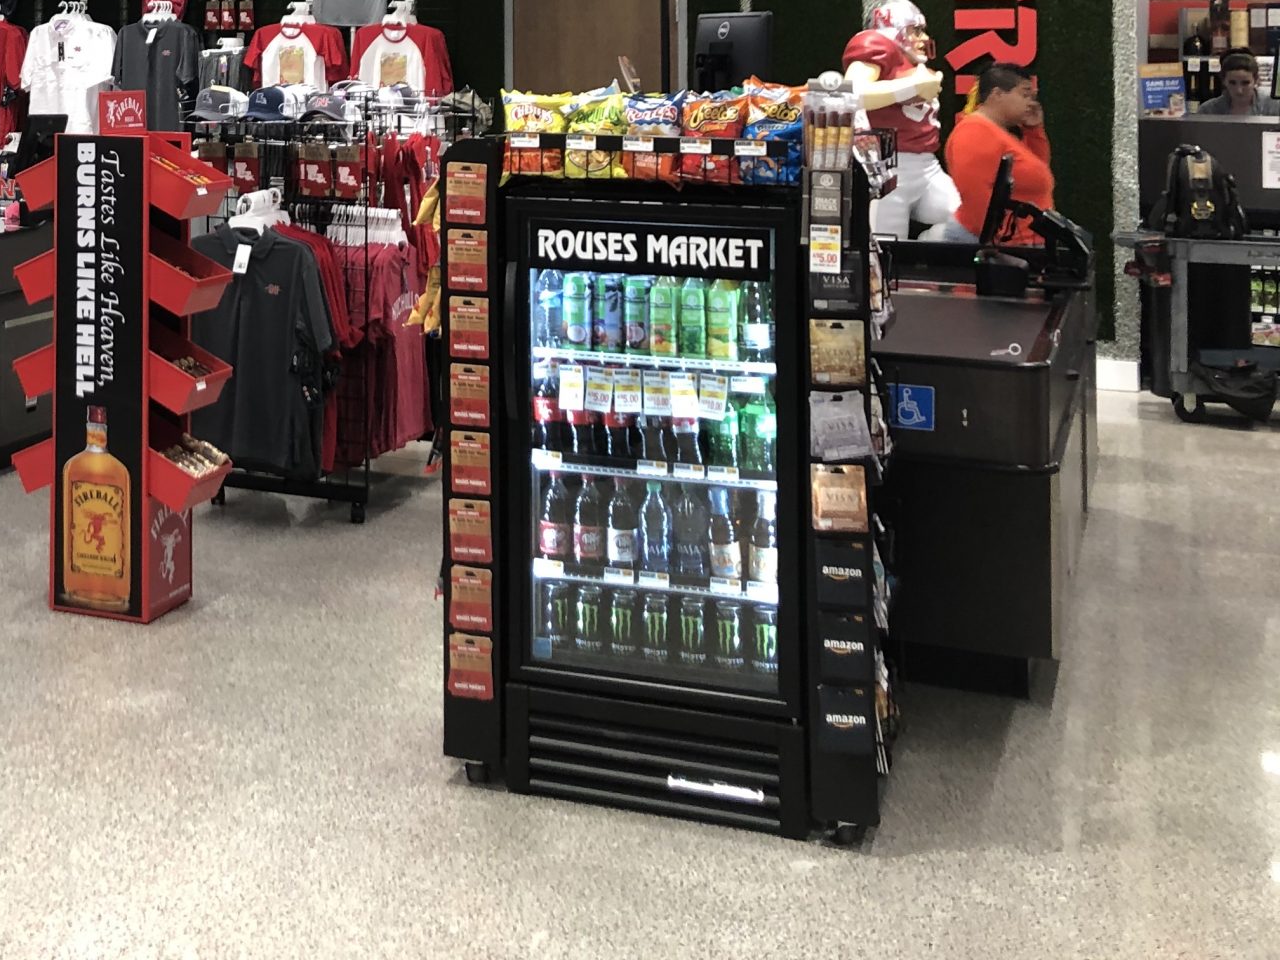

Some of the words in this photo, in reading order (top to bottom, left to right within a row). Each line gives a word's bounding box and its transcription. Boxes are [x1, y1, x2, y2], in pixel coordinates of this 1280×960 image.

[76, 142, 96, 248] BURNS
[100, 150, 125, 226] Tastes
[100, 233, 125, 285] Like
[538, 229, 638, 262] ROUSES
[647, 234, 764, 270] MARKET
[76, 253, 96, 321] LIKE
[823, 275, 850, 284] VISA
[75, 324, 96, 398] HELL
[96, 291, 125, 388] Heaven,
[74, 489, 121, 513] FIREBALL
[822, 565, 862, 578] amazon
[823, 639, 864, 652] amazon
[826, 713, 866, 725] amazon
